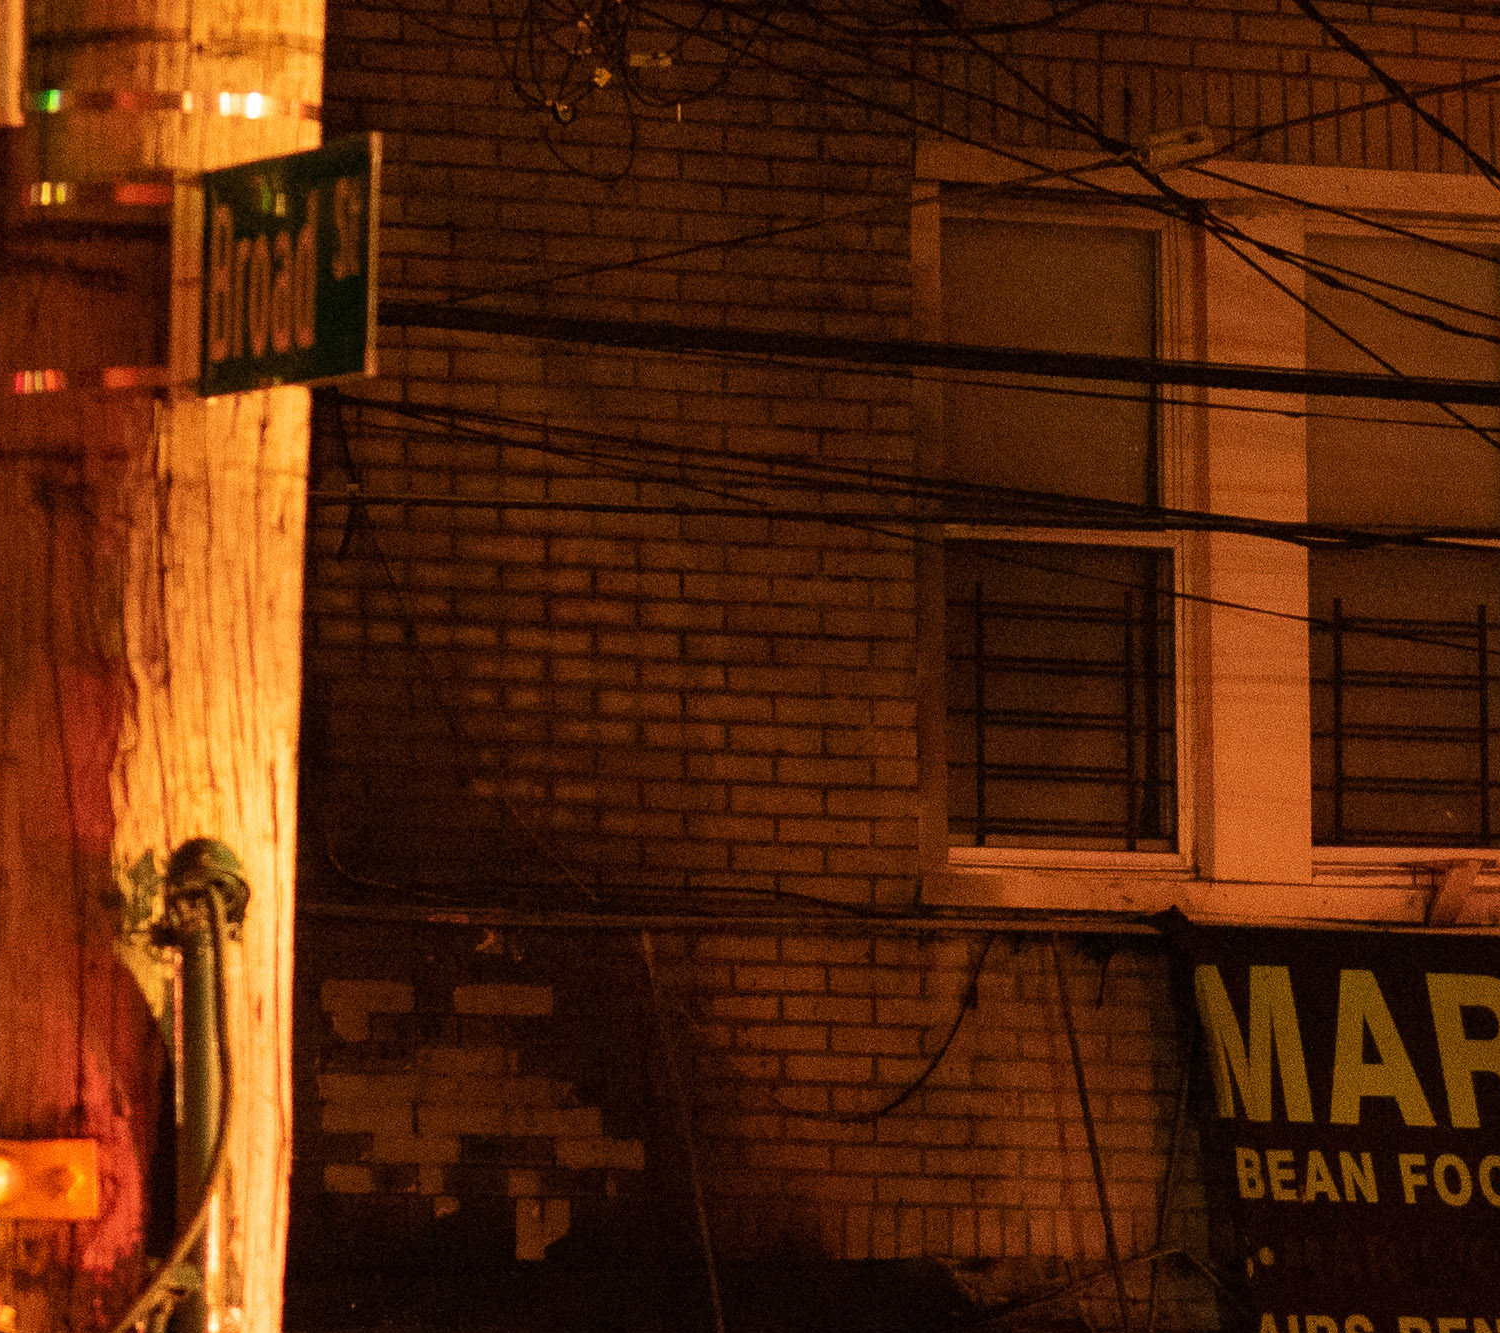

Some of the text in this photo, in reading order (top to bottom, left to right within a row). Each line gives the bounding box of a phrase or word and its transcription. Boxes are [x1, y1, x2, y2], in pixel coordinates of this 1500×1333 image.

[208, 175, 362, 362] Broad St
[1235, 1147, 1379, 1205] BEAN
